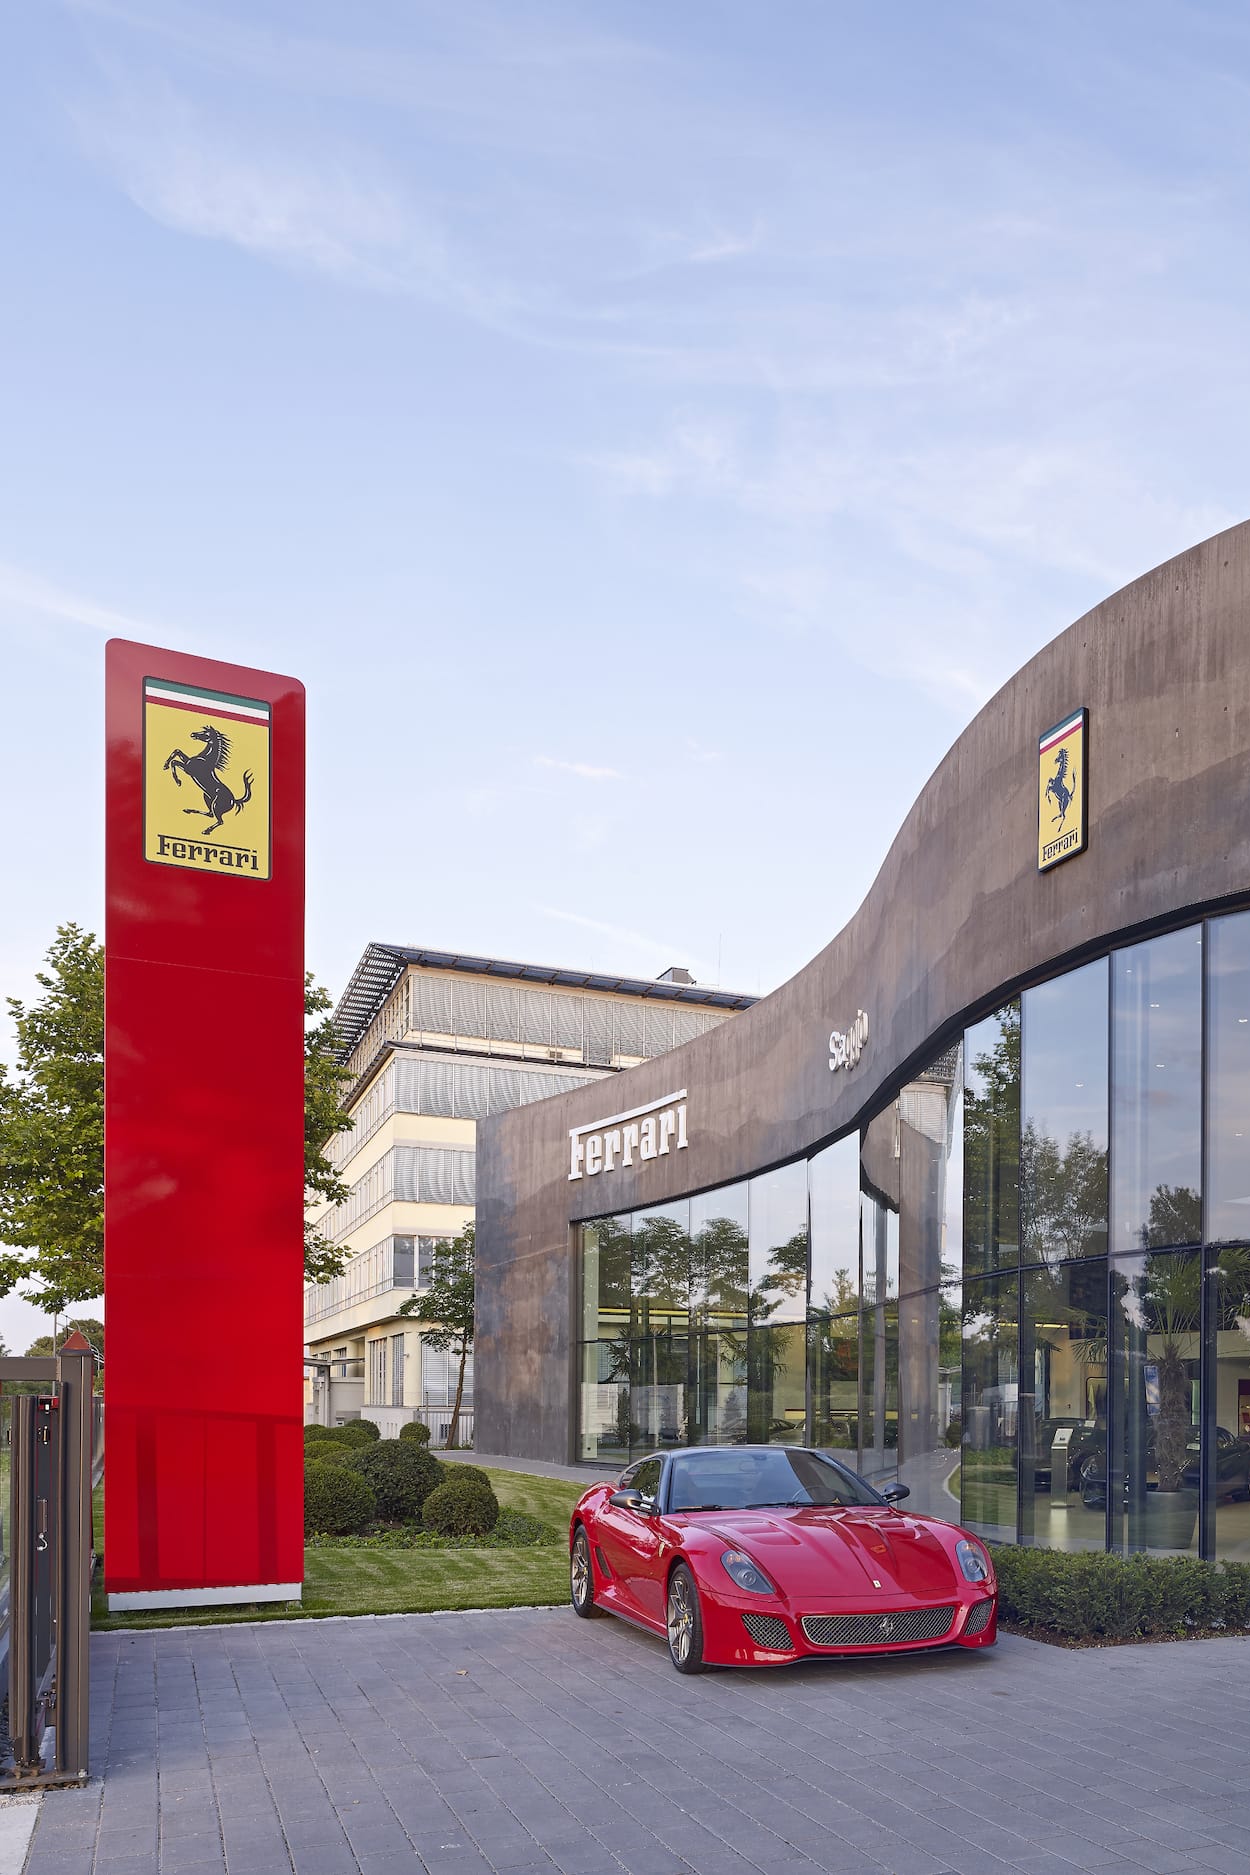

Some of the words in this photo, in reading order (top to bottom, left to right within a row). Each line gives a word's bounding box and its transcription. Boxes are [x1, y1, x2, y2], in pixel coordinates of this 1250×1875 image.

[156, 834, 259, 870] Ferrari
[1042, 828, 1078, 862] Ferrari
[568, 1088, 688, 1181] Ferrari
